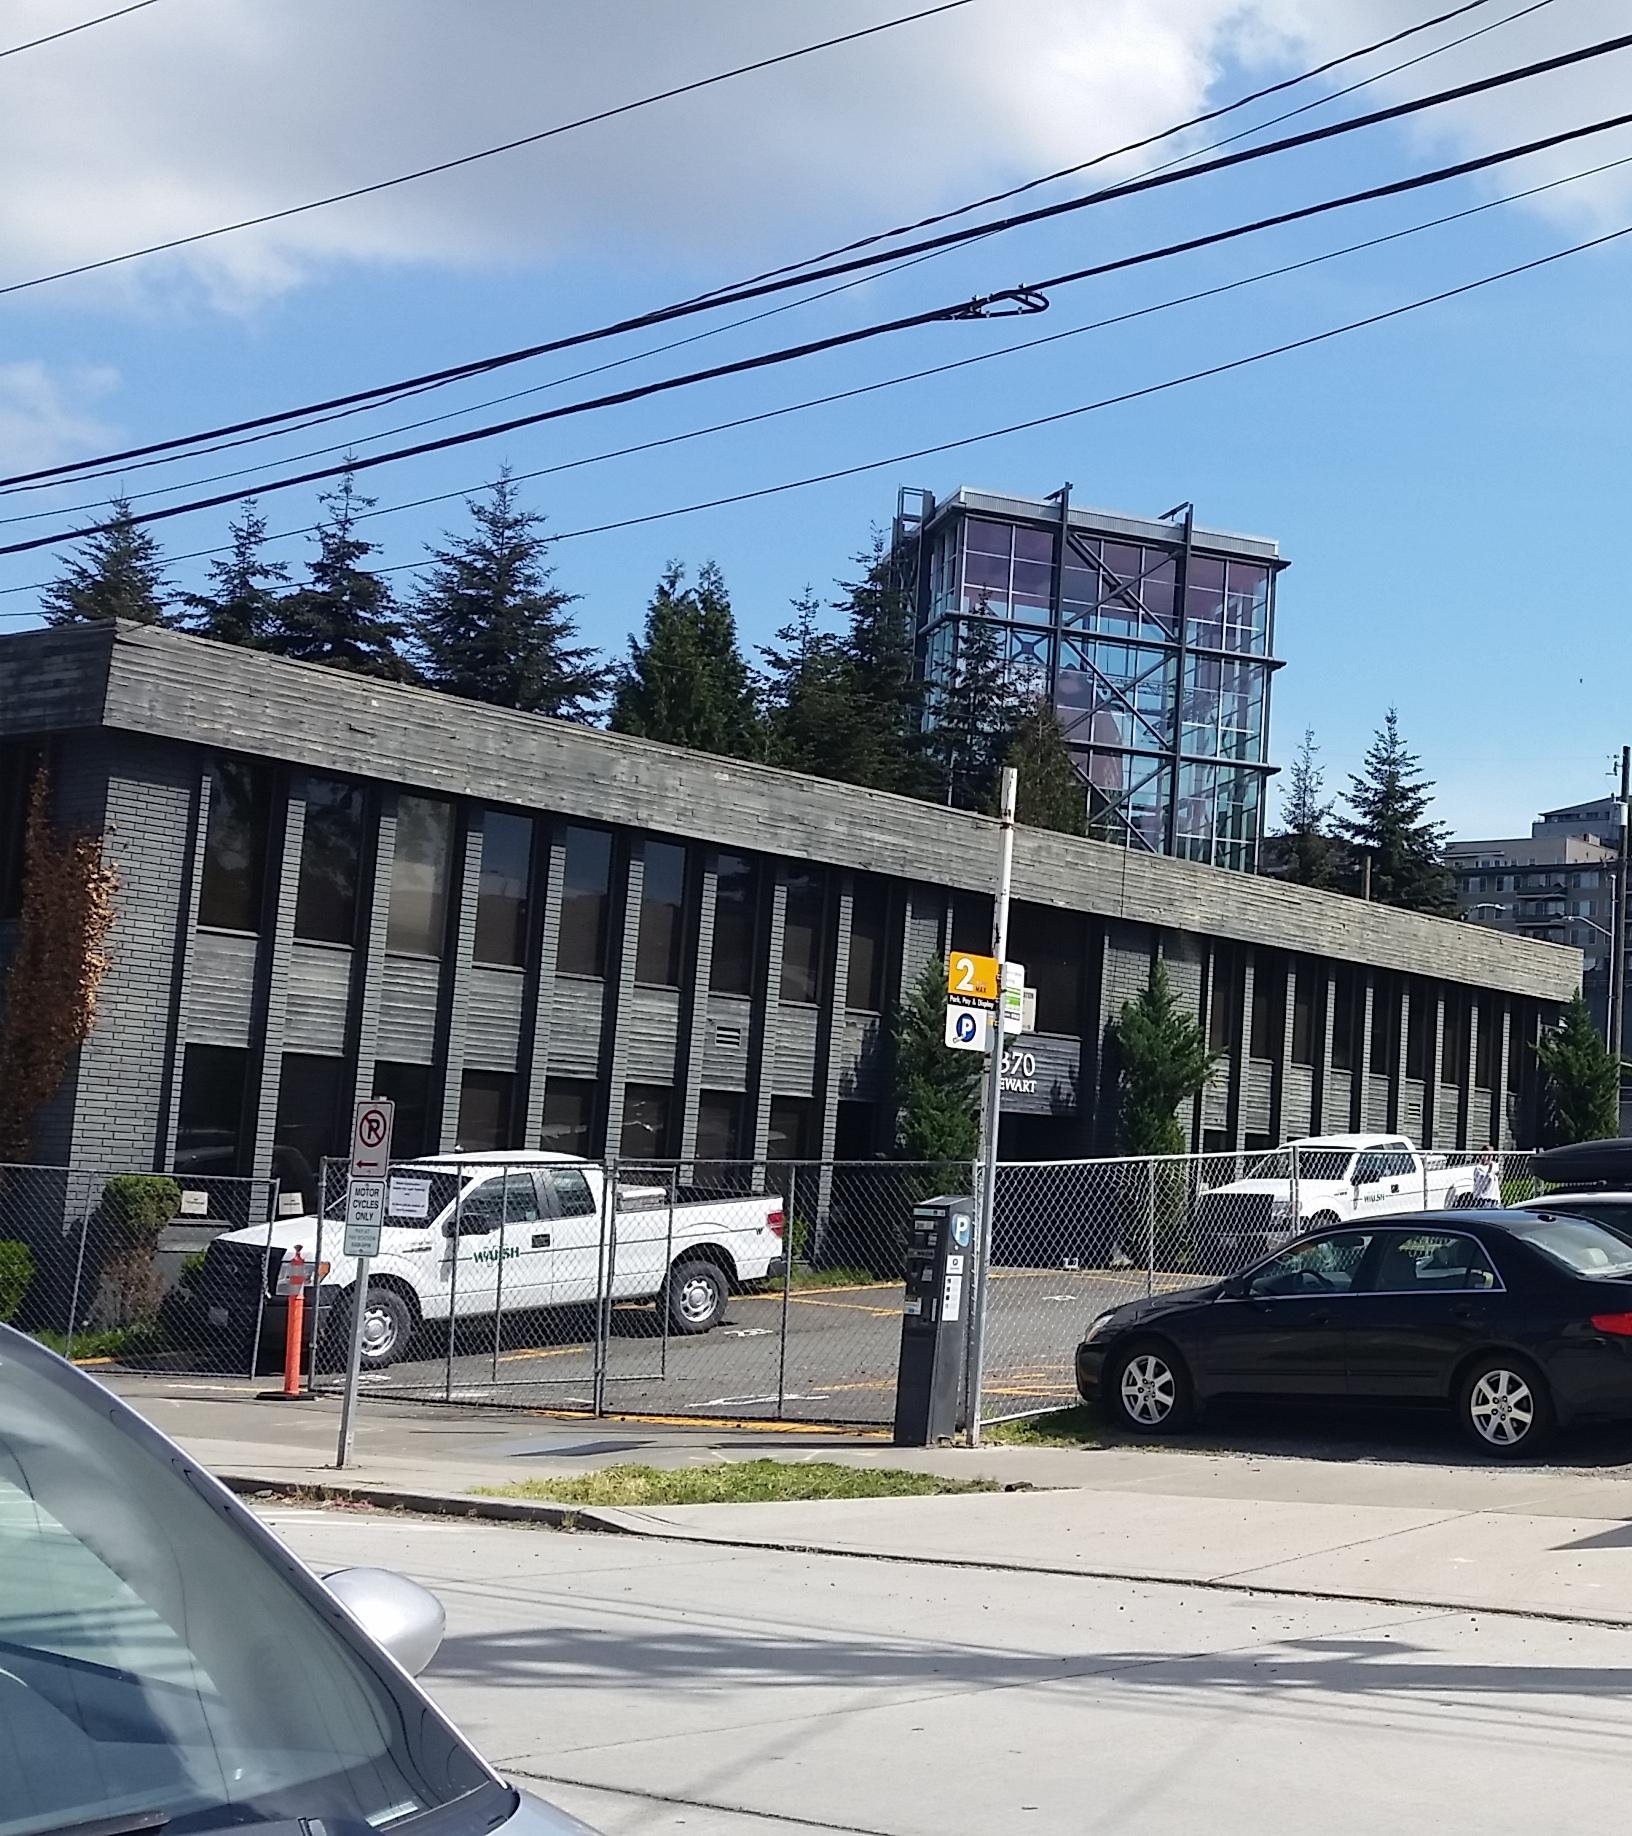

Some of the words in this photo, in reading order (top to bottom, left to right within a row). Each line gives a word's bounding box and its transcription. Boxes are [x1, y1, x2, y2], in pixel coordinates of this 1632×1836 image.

[955, 958, 975, 992] 2
[977, 999, 994, 1009] Display
[354, 1187, 380, 1197] MOTOR
[352, 1200, 379, 1210] CYCLES
[355, 1211, 374, 1221] ONLY
